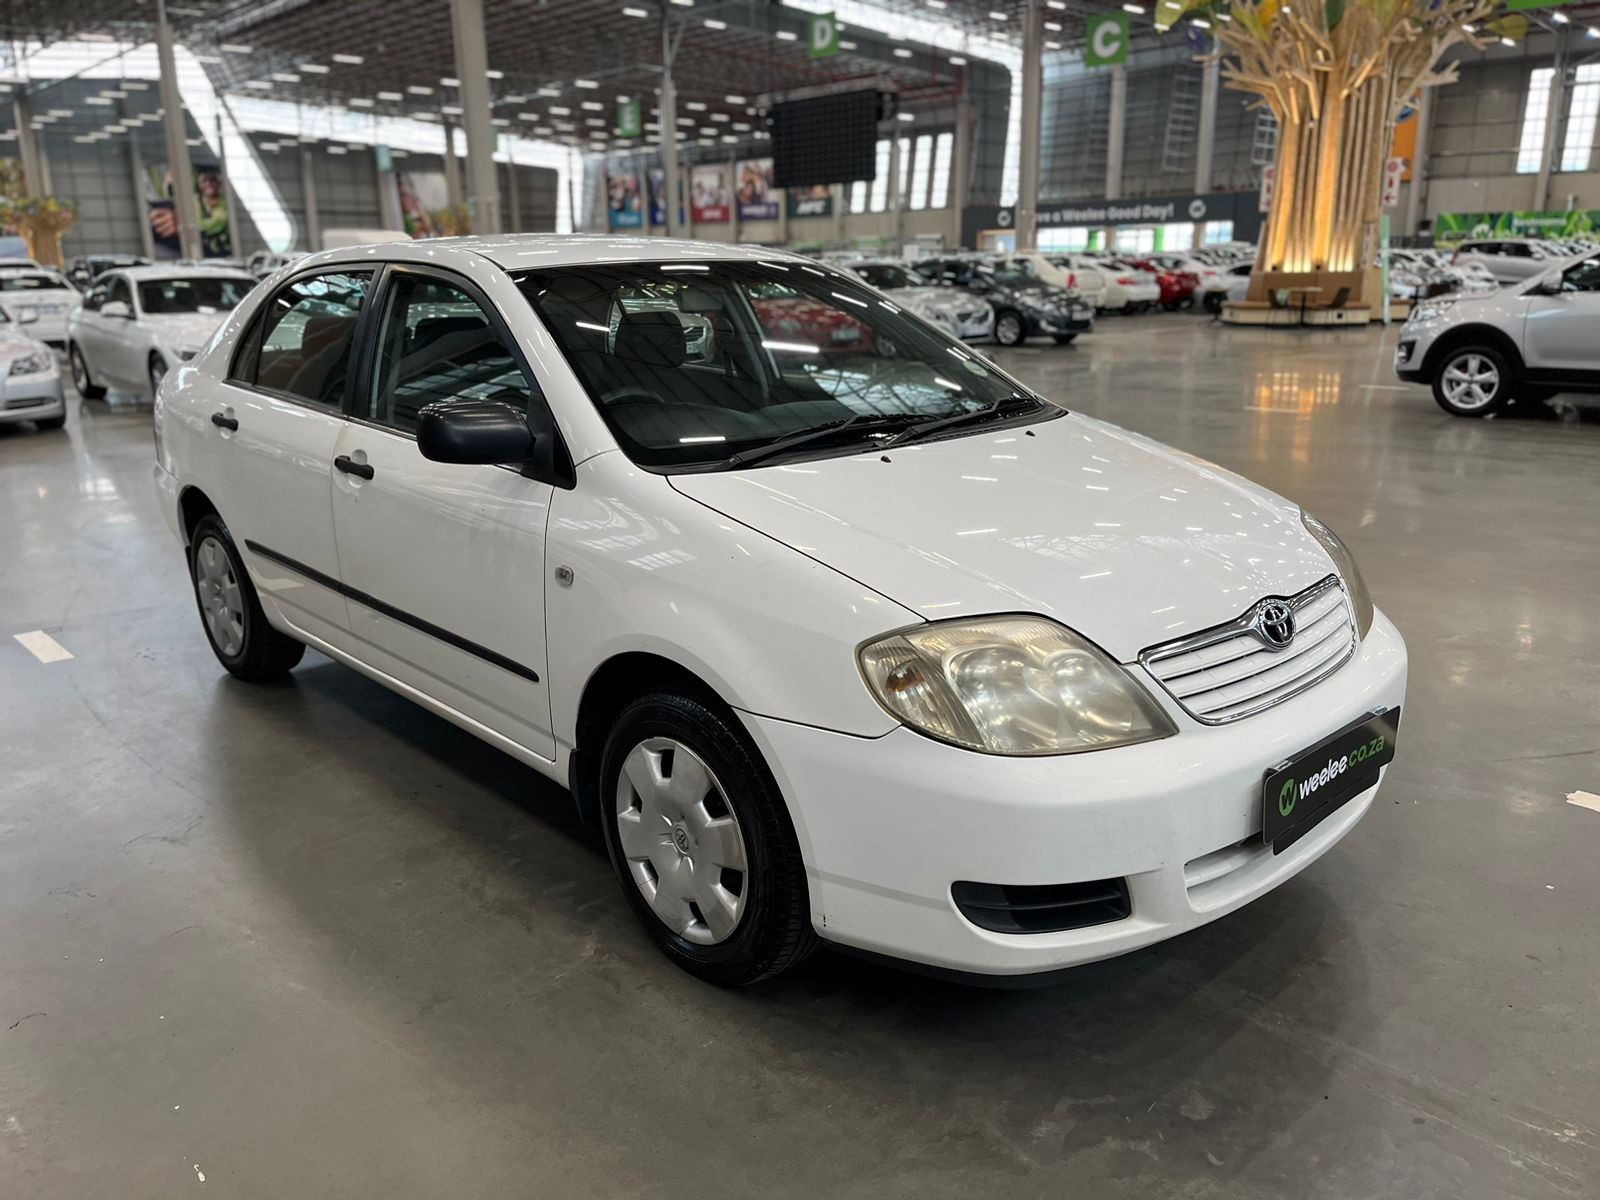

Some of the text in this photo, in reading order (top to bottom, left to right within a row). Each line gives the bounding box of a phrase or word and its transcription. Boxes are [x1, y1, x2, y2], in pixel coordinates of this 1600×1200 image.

[813, 20, 832, 49] D
[1093, 21, 1121, 58] C
[1052, 211, 1060, 222] a
[1107, 206, 1141, 220] Good
[1143, 203, 1174, 221] Day!
